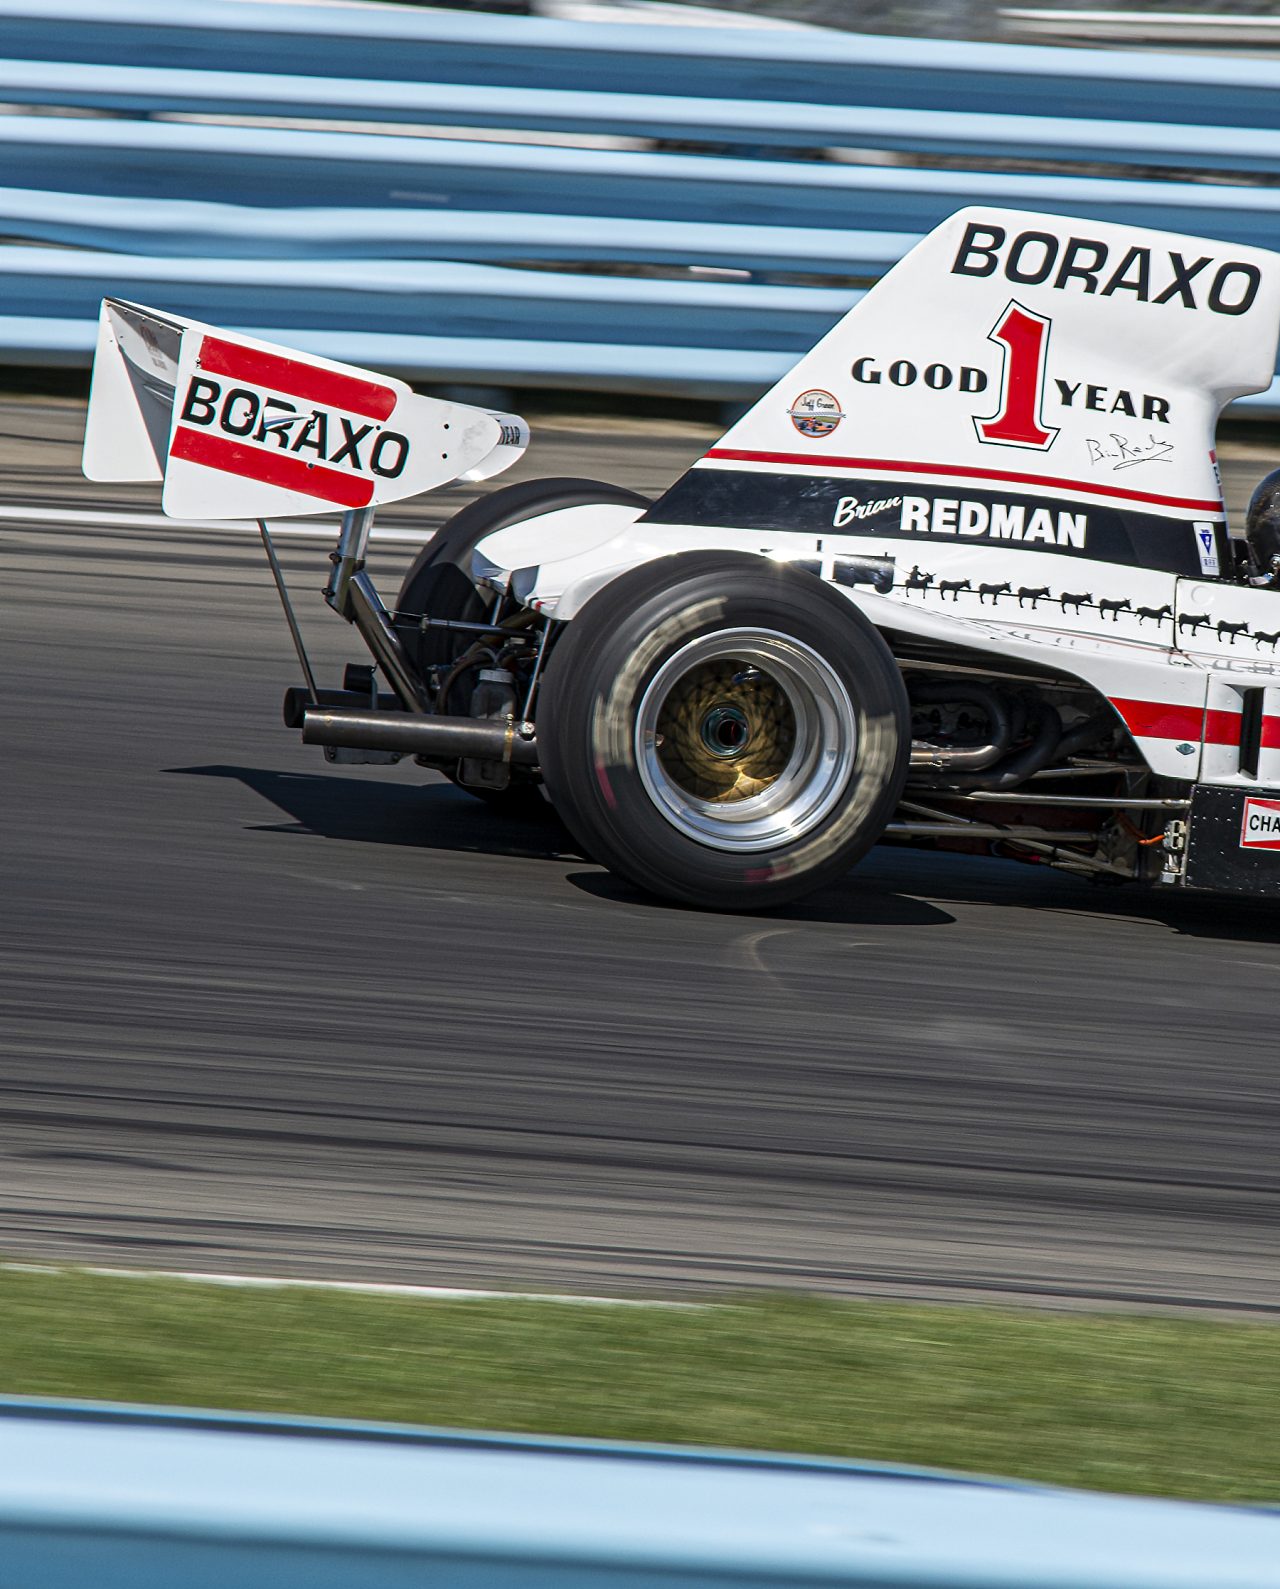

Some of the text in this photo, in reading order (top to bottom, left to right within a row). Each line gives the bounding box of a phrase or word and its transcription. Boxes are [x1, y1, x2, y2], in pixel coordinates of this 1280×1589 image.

[951, 222, 1262, 316] BORAXO
[851, 357, 1171, 424] GOOD YEAR
[972, 298, 1060, 452] 1
[181, 375, 410, 479] BORAXO
[832, 495, 1088, 549] Brian REDMAN
